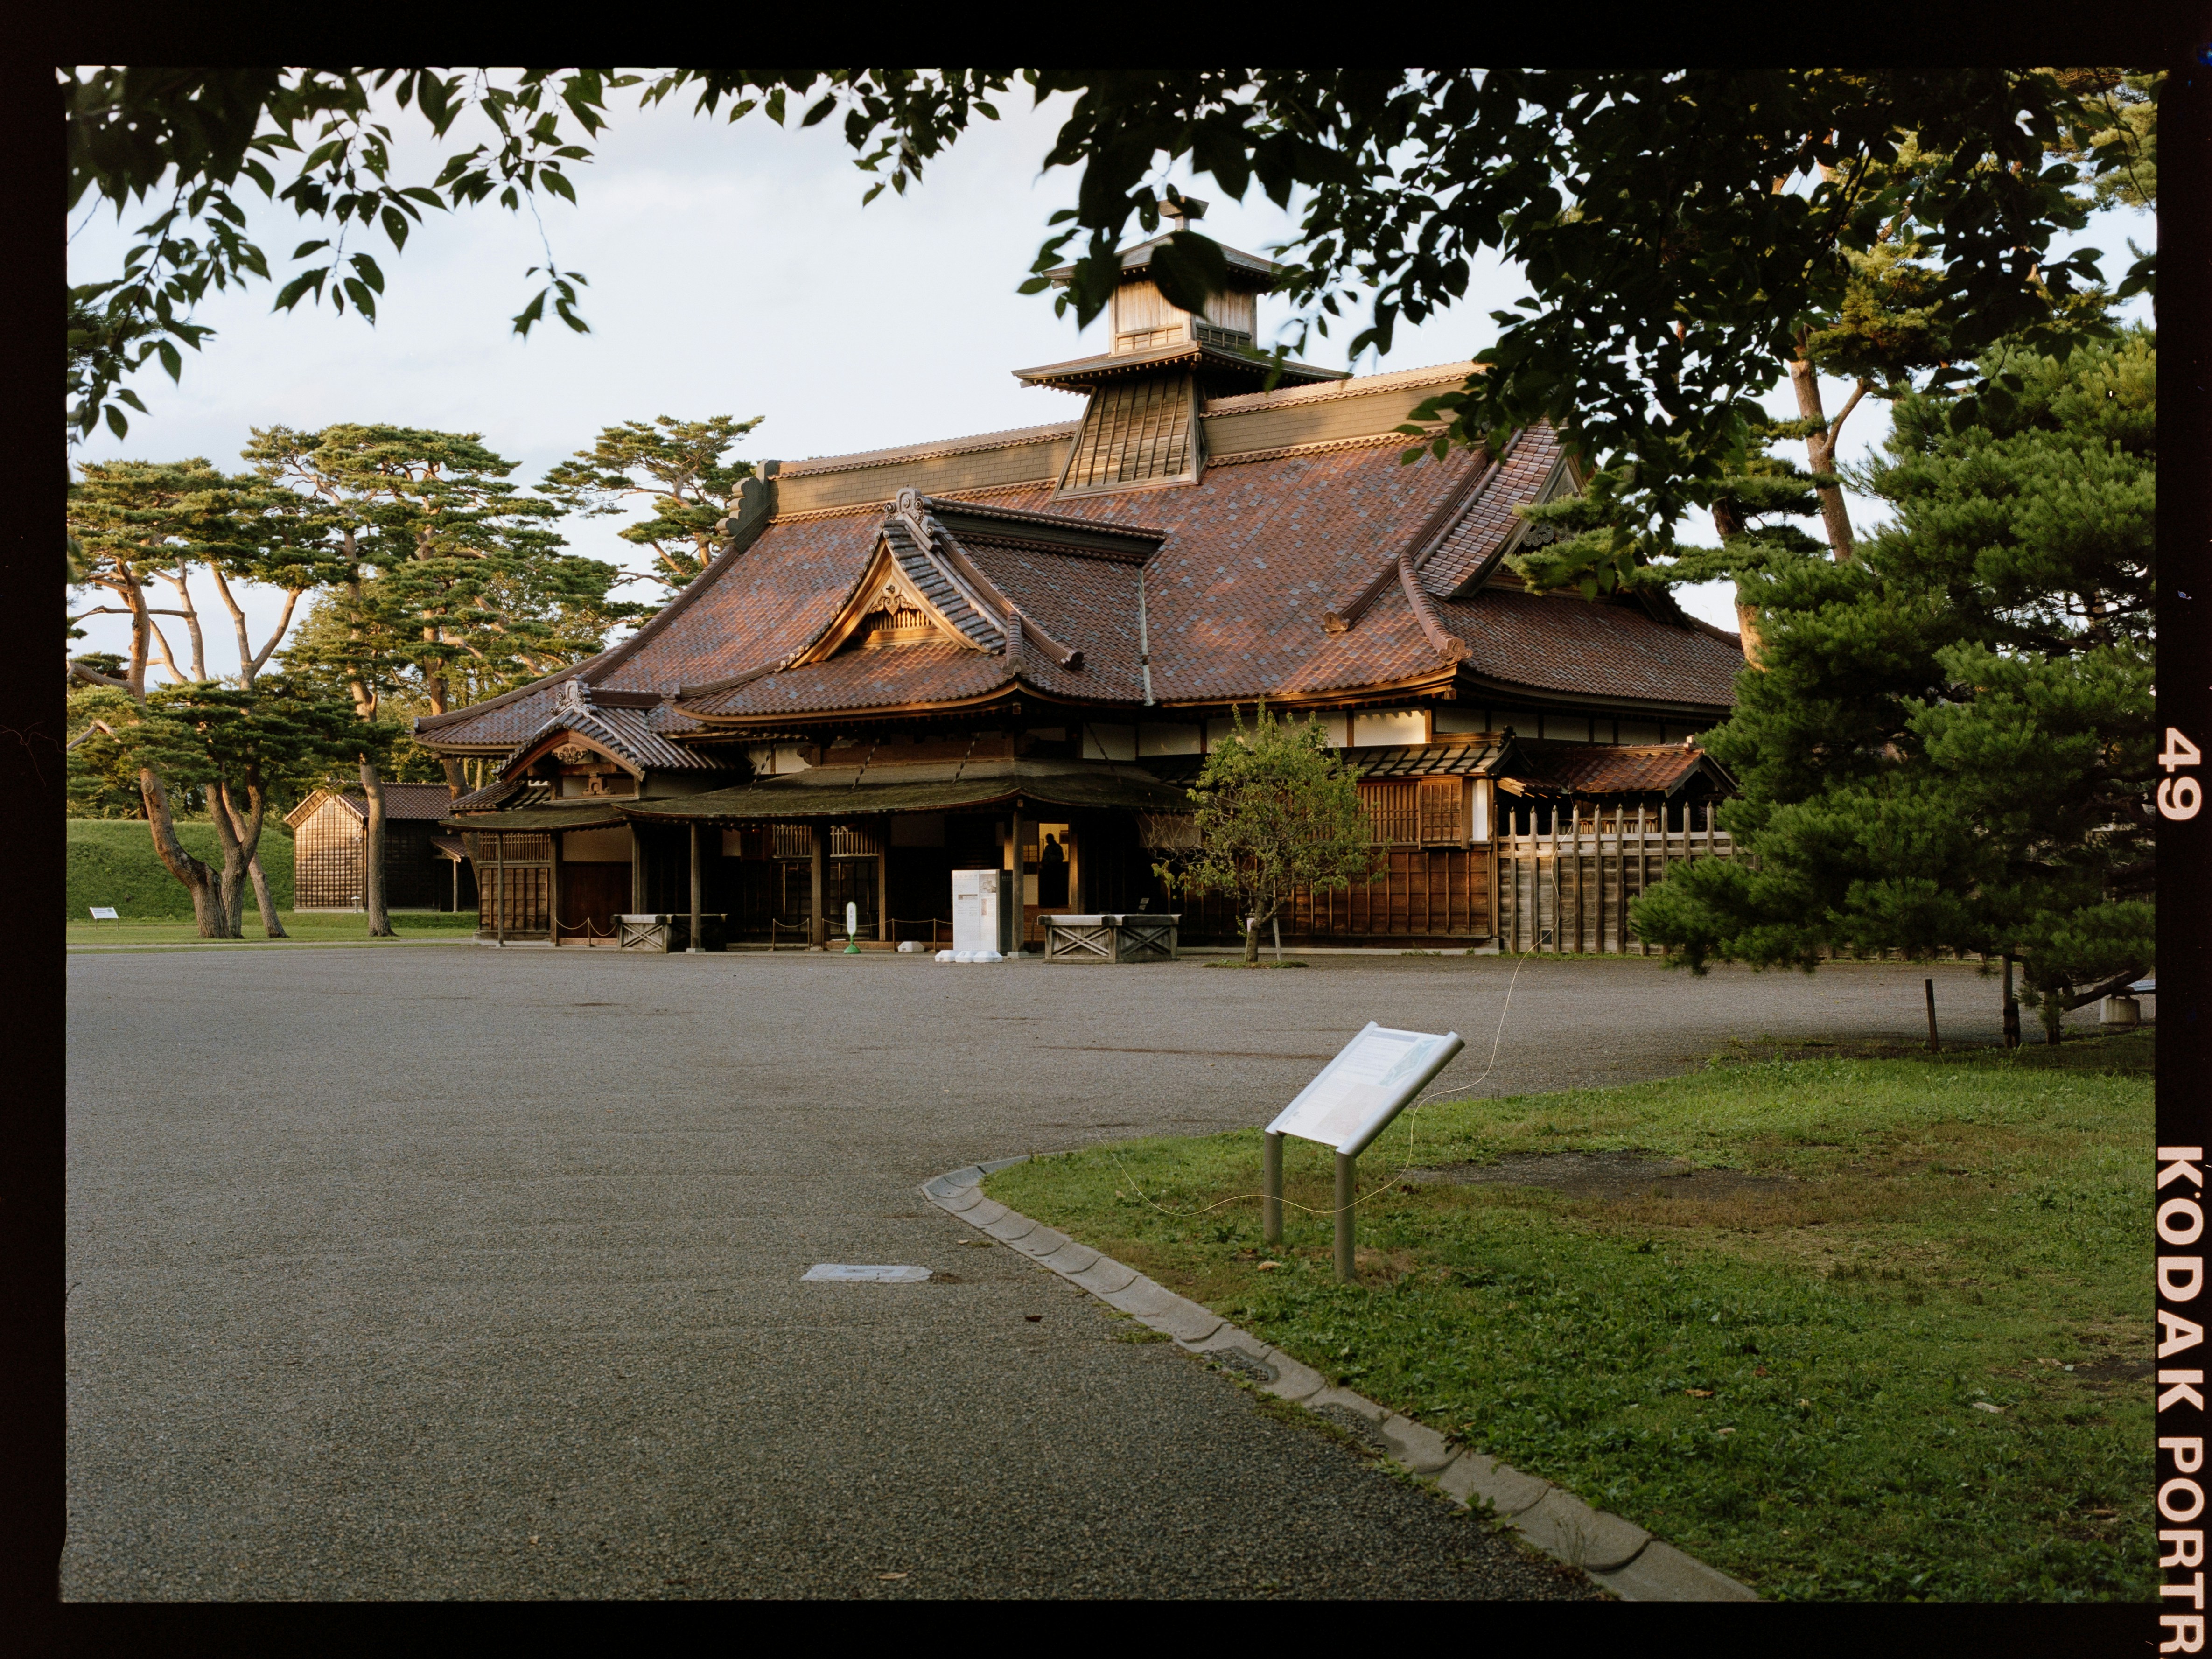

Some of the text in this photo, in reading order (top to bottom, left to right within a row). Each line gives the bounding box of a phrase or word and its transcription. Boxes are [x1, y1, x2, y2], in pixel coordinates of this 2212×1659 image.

[2157, 728, 2202, 820] 49
[2157, 1147, 2204, 1659] KODAK PORTR
